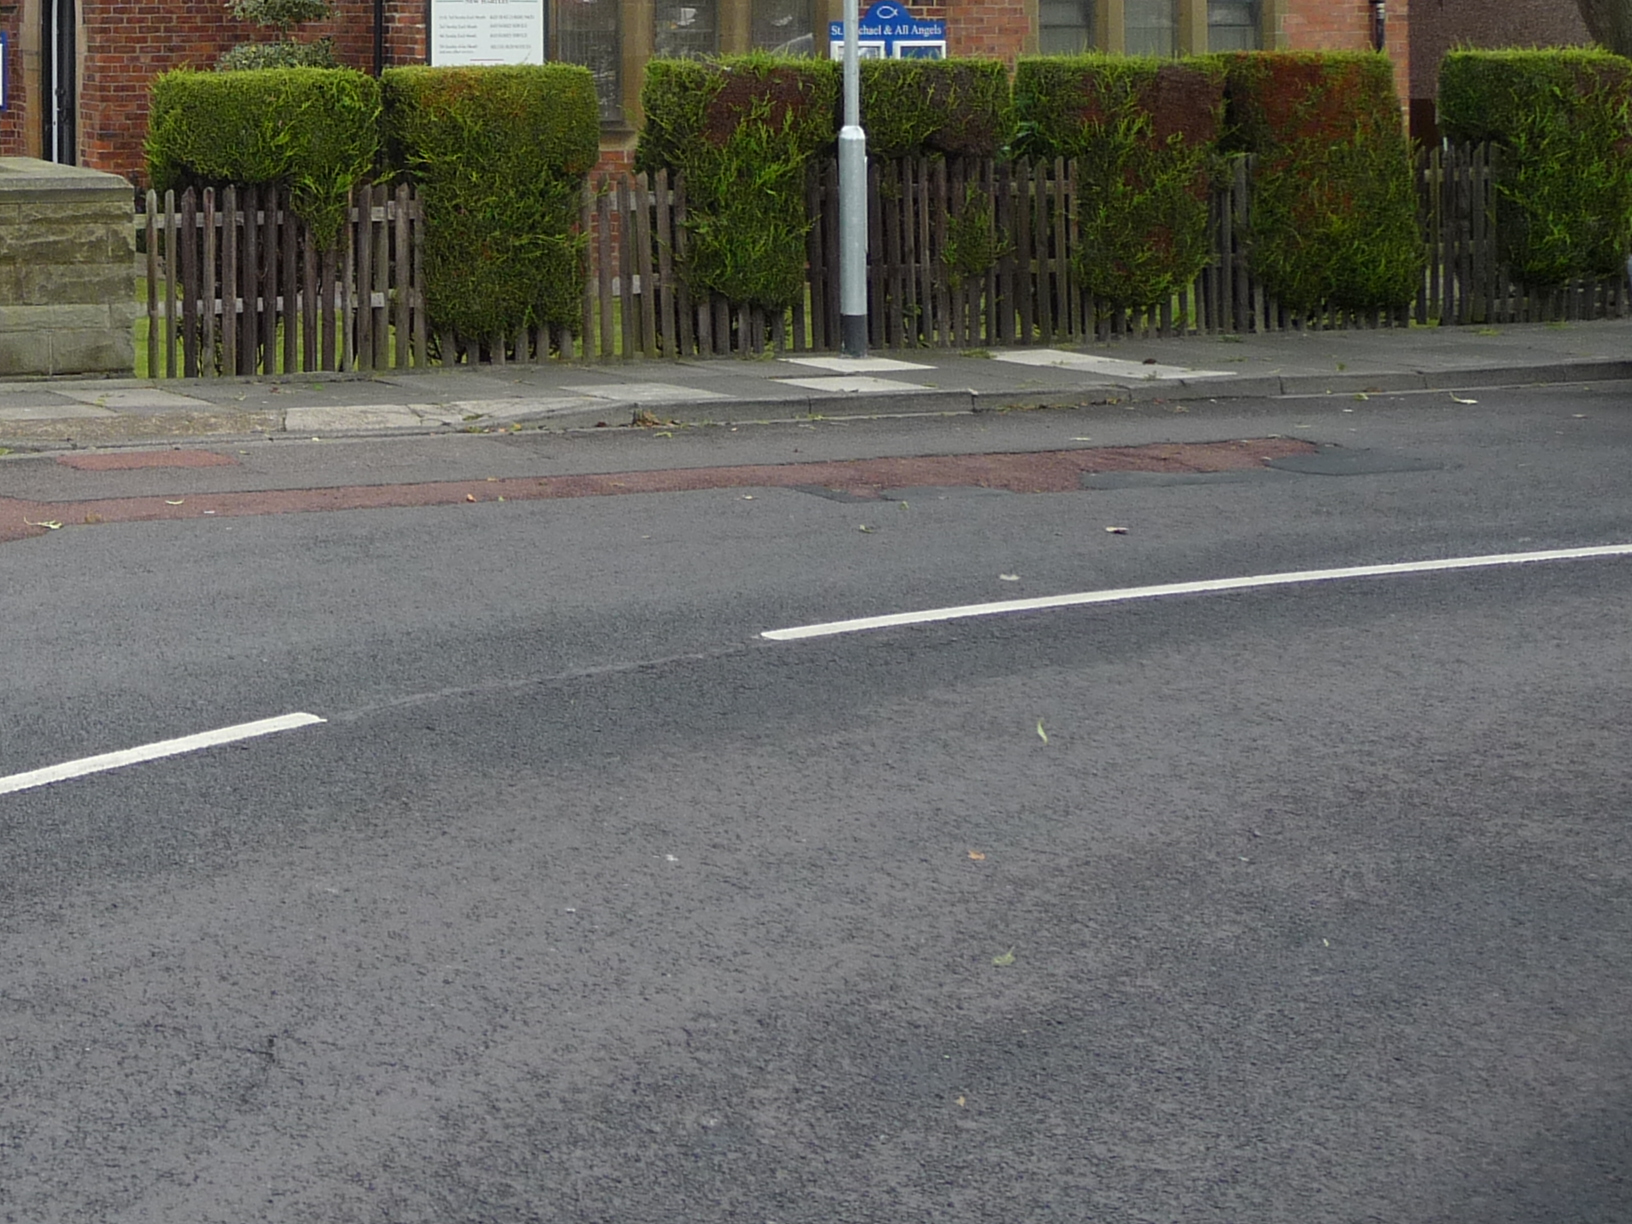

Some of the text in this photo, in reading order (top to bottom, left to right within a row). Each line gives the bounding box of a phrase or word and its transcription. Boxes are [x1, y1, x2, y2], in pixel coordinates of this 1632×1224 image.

[831, 26, 843, 35] St.
[884, 26, 892, 35] &
[895, 25, 908, 35] All
[911, 25, 942, 37] Angels
